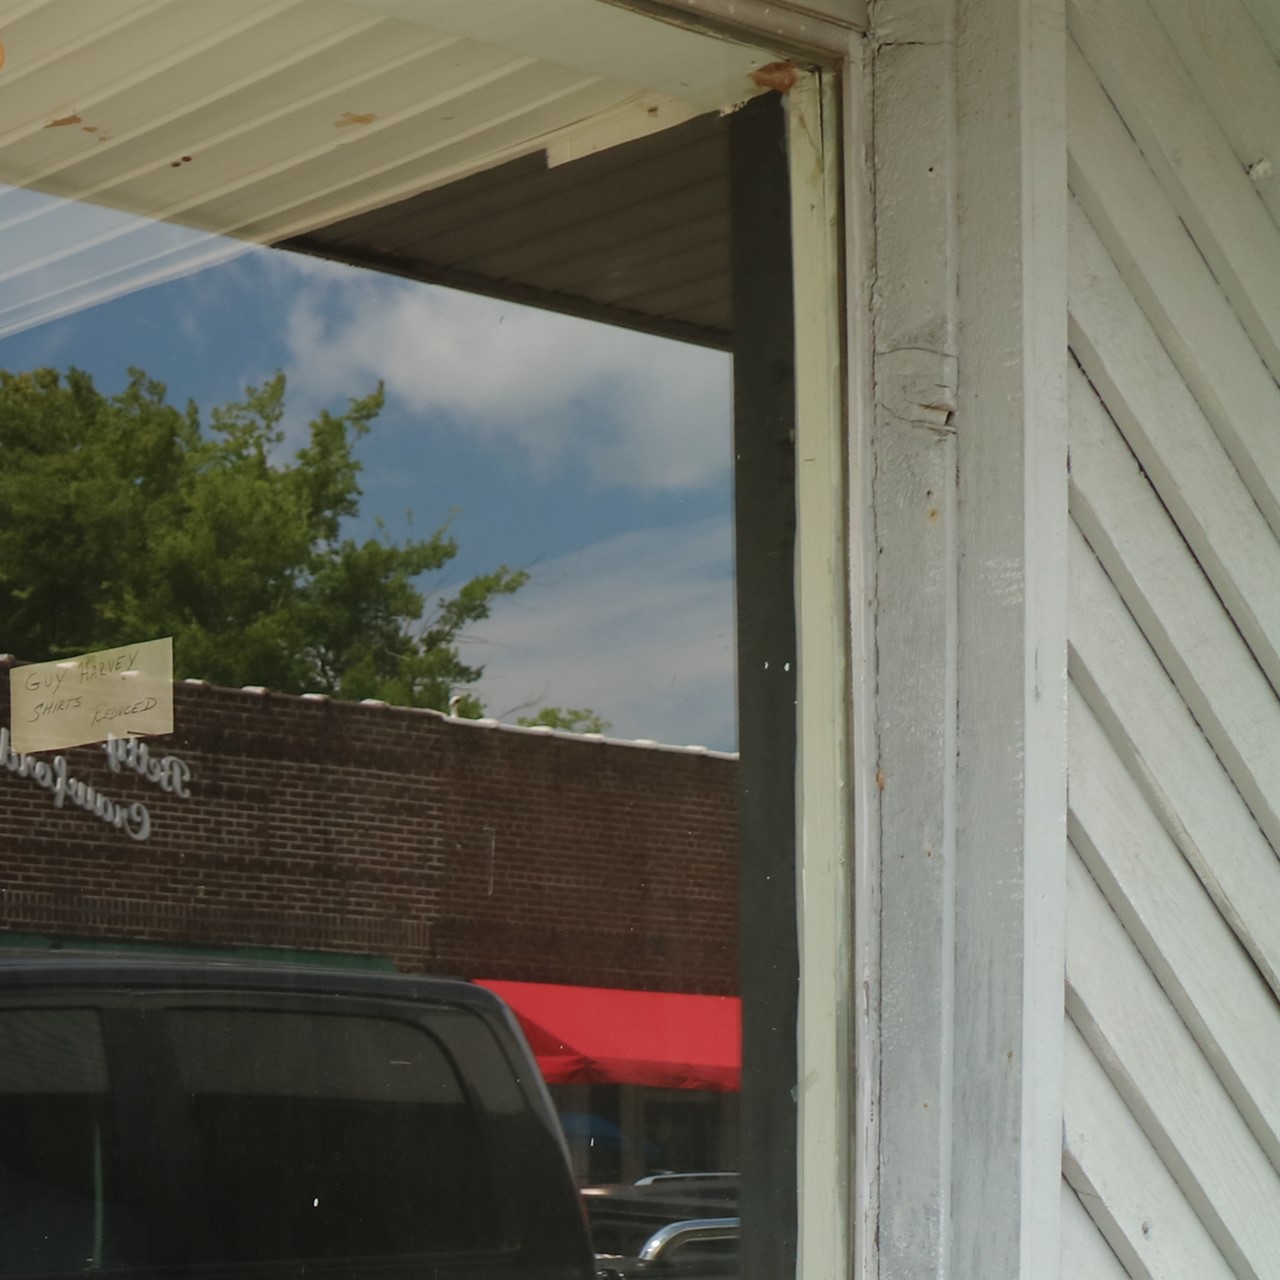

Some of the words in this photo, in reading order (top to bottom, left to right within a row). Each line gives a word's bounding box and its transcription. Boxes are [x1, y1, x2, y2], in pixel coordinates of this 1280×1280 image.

[25, 669, 67, 695] GUY
[78, 650, 139, 684] HARVEY
[28, 696, 83, 723] SHIRTS
[91, 697, 157, 727] REDUCED
